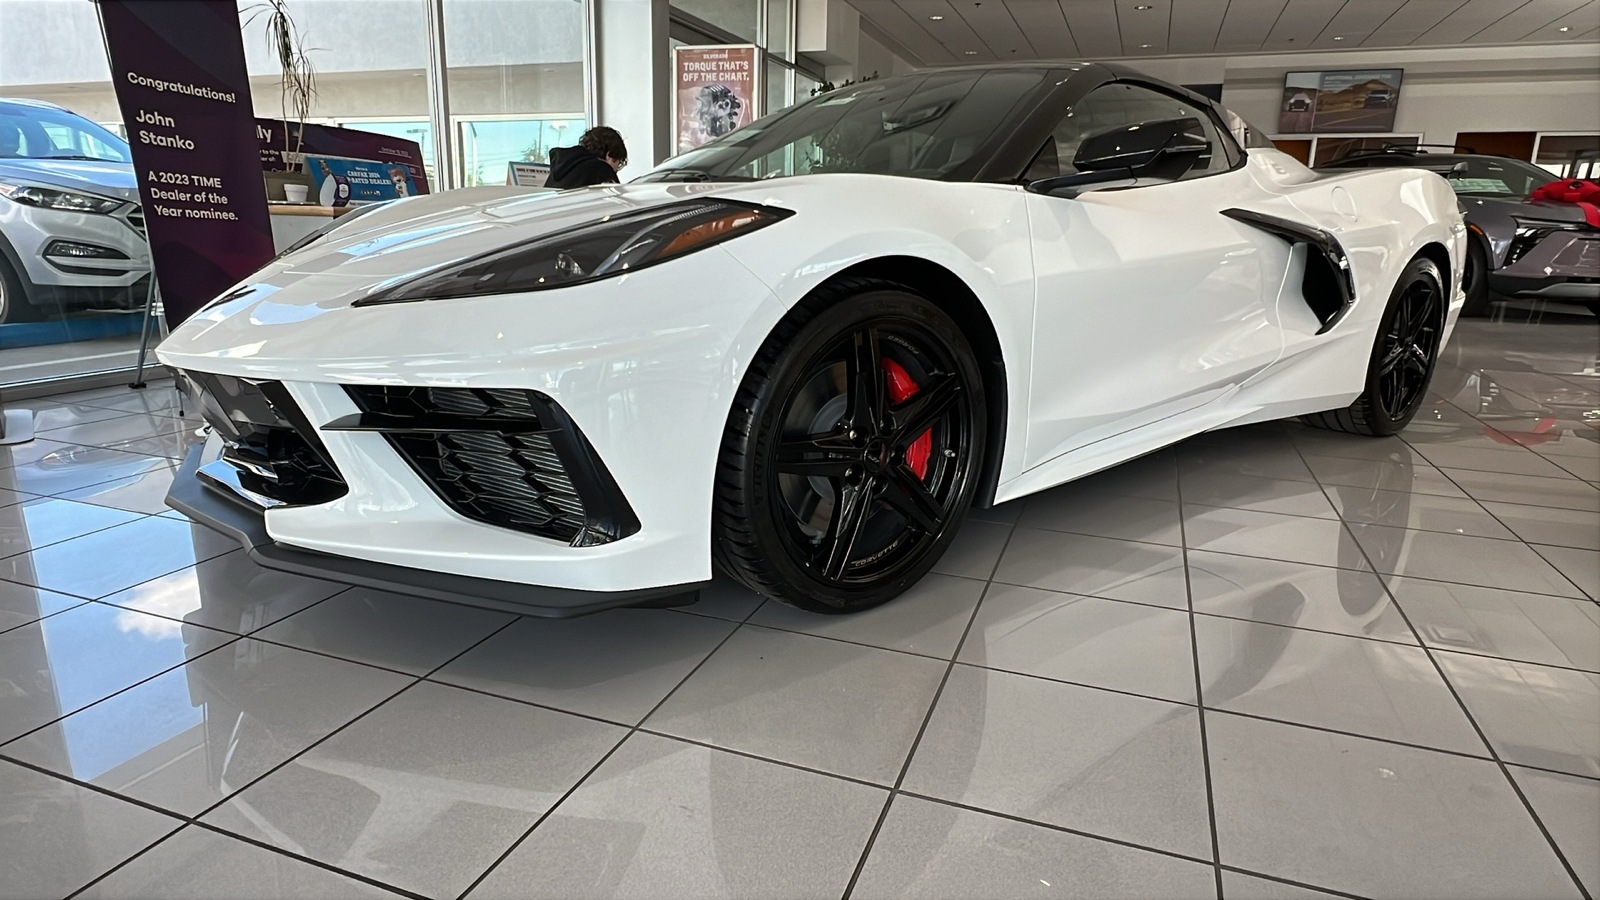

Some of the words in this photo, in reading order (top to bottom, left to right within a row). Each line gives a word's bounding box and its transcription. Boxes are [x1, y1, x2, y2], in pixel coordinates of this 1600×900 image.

[683, 61, 717, 71] TORQUE
[718, 60, 749, 70] THAT'S
[682, 72, 699, 82] OFF
[700, 72, 718, 82] THE
[718, 71, 750, 81] CHART.
[127, 71, 236, 103] Congratulations!
[135, 109, 175, 128] John
[139, 130, 195, 150] Stanko
[148, 170, 158, 182] A
[159, 172, 190, 186] 2023
[191, 175, 222, 188] TIME
[150, 187, 192, 201] Dealer
[194, 191, 206, 203] of
[208, 192, 228, 204] the
[154, 204, 183, 217] Year
[185, 208, 239, 220] nominee.
[887, 335, 919, 355] FORGED
[854, 539, 899, 567] CORVETTE
